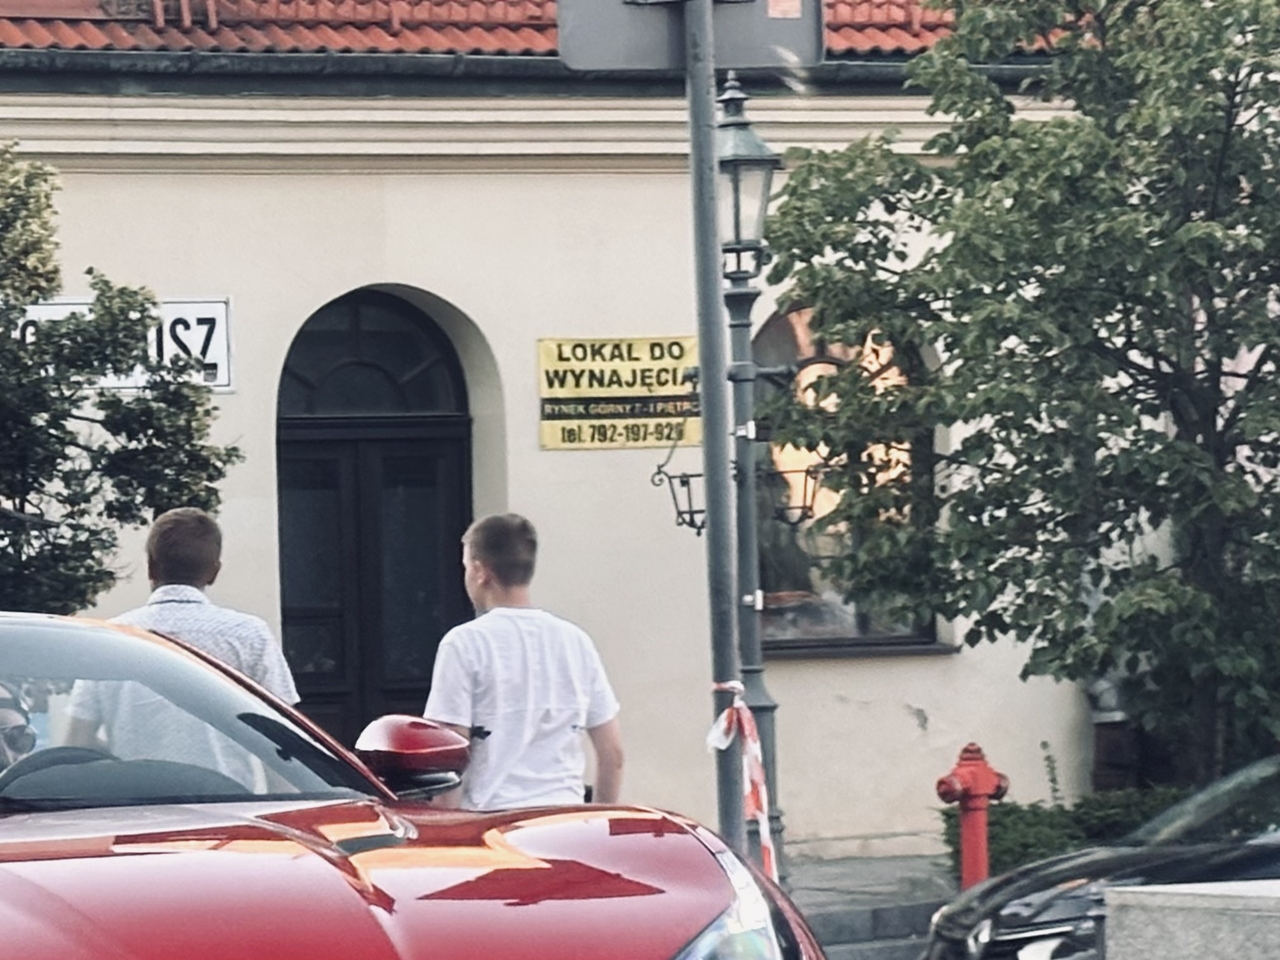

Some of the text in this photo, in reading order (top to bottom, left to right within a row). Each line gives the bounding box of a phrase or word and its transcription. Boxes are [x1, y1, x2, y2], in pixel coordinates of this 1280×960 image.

[556, 341, 685, 362] LOKAL DO
[544, 403, 586, 415] RYNEK
[561, 425, 586, 443] tel.
